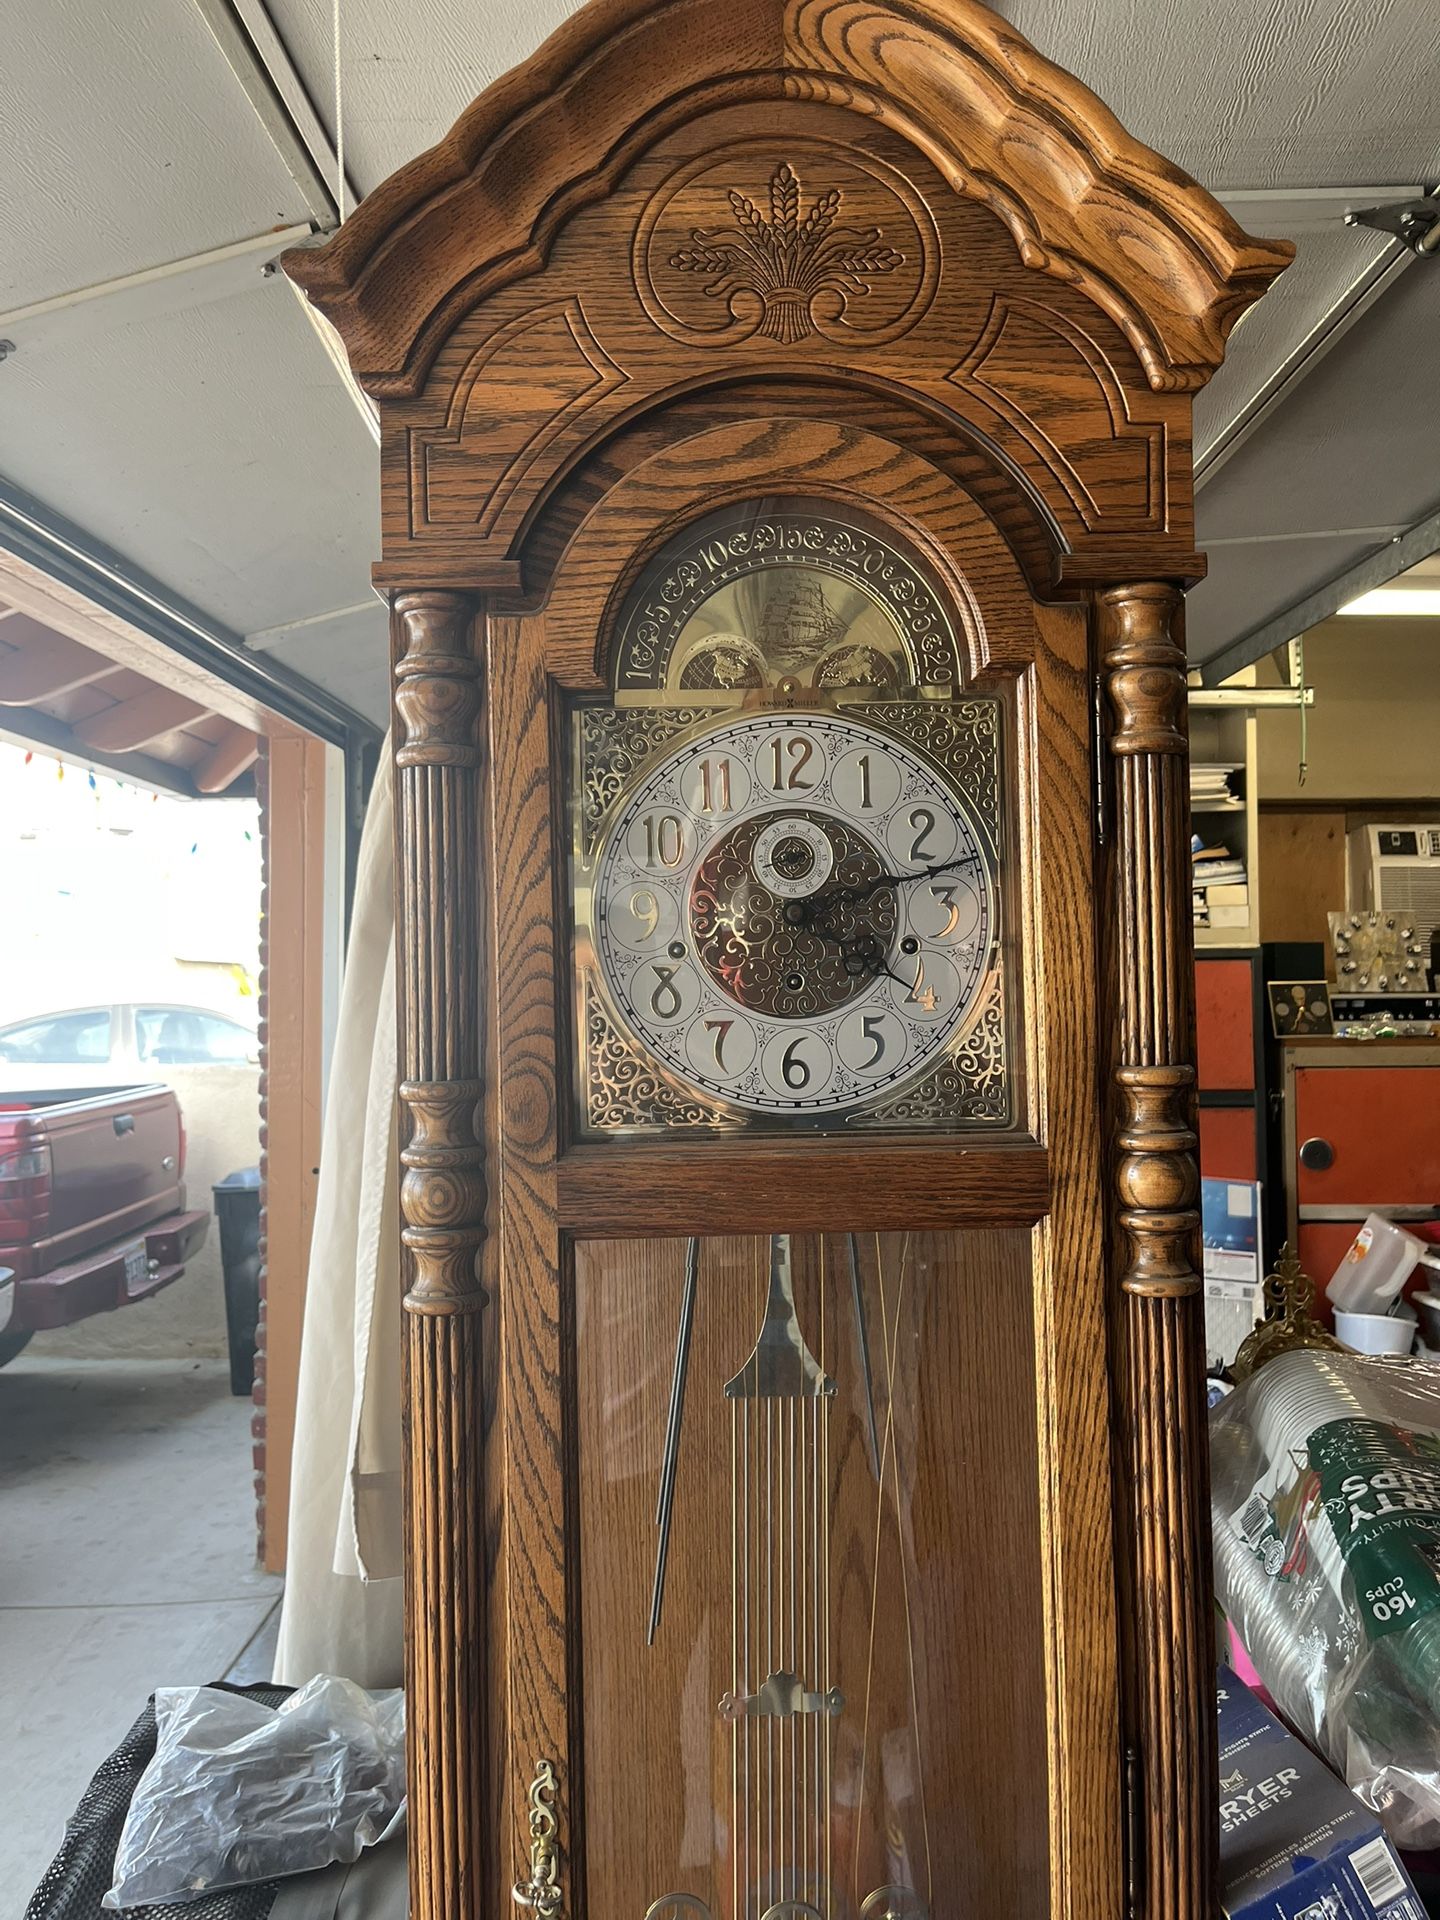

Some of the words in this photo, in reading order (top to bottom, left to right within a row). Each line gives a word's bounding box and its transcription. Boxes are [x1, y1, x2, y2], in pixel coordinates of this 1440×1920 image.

[698, 540, 729, 573] 10
[776, 524, 803, 550] 15
[846, 539, 885, 575] 20
[644, 603, 671, 623] 5
[902, 596, 938, 633] 25
[923, 650, 952, 684] 29
[698, 758, 734, 814] 11
[770, 737, 815, 792] 12
[856, 754, 873, 809] 1
[642, 814, 684, 868] 10
[908, 808, 936, 863] 2
[629, 890, 661, 943] 9
[928, 885, 959, 939] 3
[650, 965, 683, 1019] 8
[902, 956, 942, 1013] 4
[703, 1020, 736, 1075] 7
[781, 1036, 810, 1090] 6
[856, 1014, 886, 1071] 5
[1341, 1469, 1440, 1501] UPS
[1365, 1576, 1405, 1602] CUPS
[1372, 1590, 1417, 1621] 160
[1219, 1767, 1301, 1820] RYER
[1221, 1787, 1293, 1833] SHEETS
[1303, 1824, 1331, 1842] FIGHTS
[1331, 1809, 1356, 1826] STATIC
[1255, 1856, 1290, 1879] SOFTENS
[1294, 1830, 1334, 1855] FRESHENS
